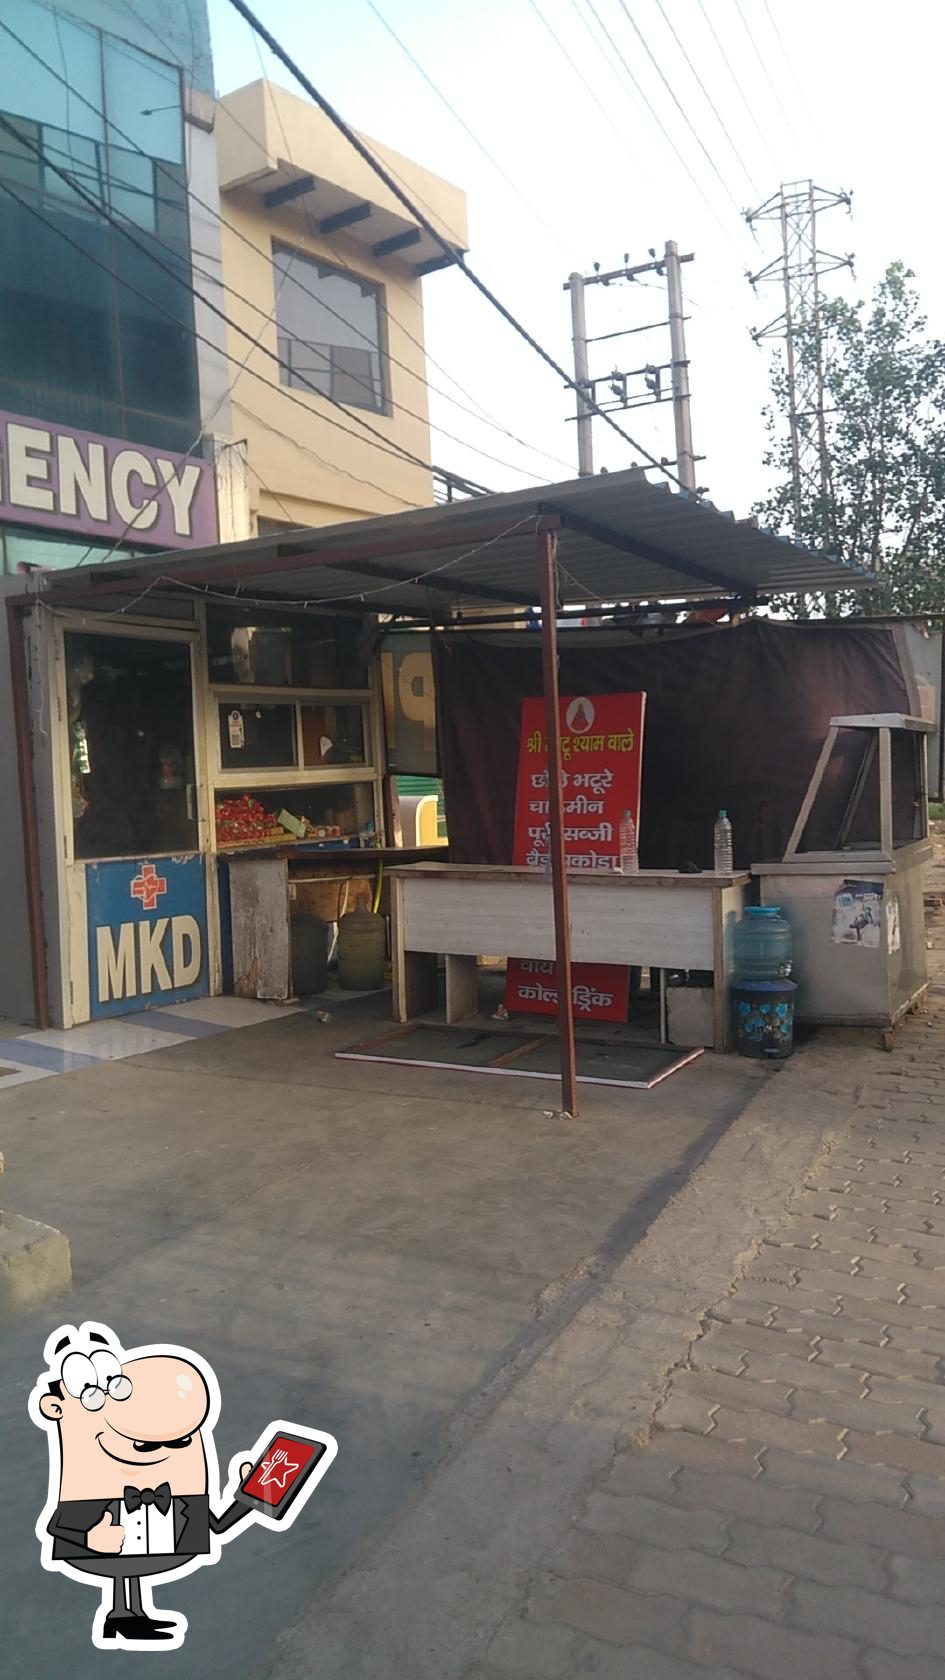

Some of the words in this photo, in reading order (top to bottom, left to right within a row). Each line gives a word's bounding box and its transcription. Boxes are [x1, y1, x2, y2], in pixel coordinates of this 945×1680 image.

[0, 423, 201, 536] ENCY
[607, 728, 634, 752] वाले
[572, 769, 614, 794] भटूरे
[528, 794, 605, 815] चामीन
[96, 914, 201, 1003] MKD
